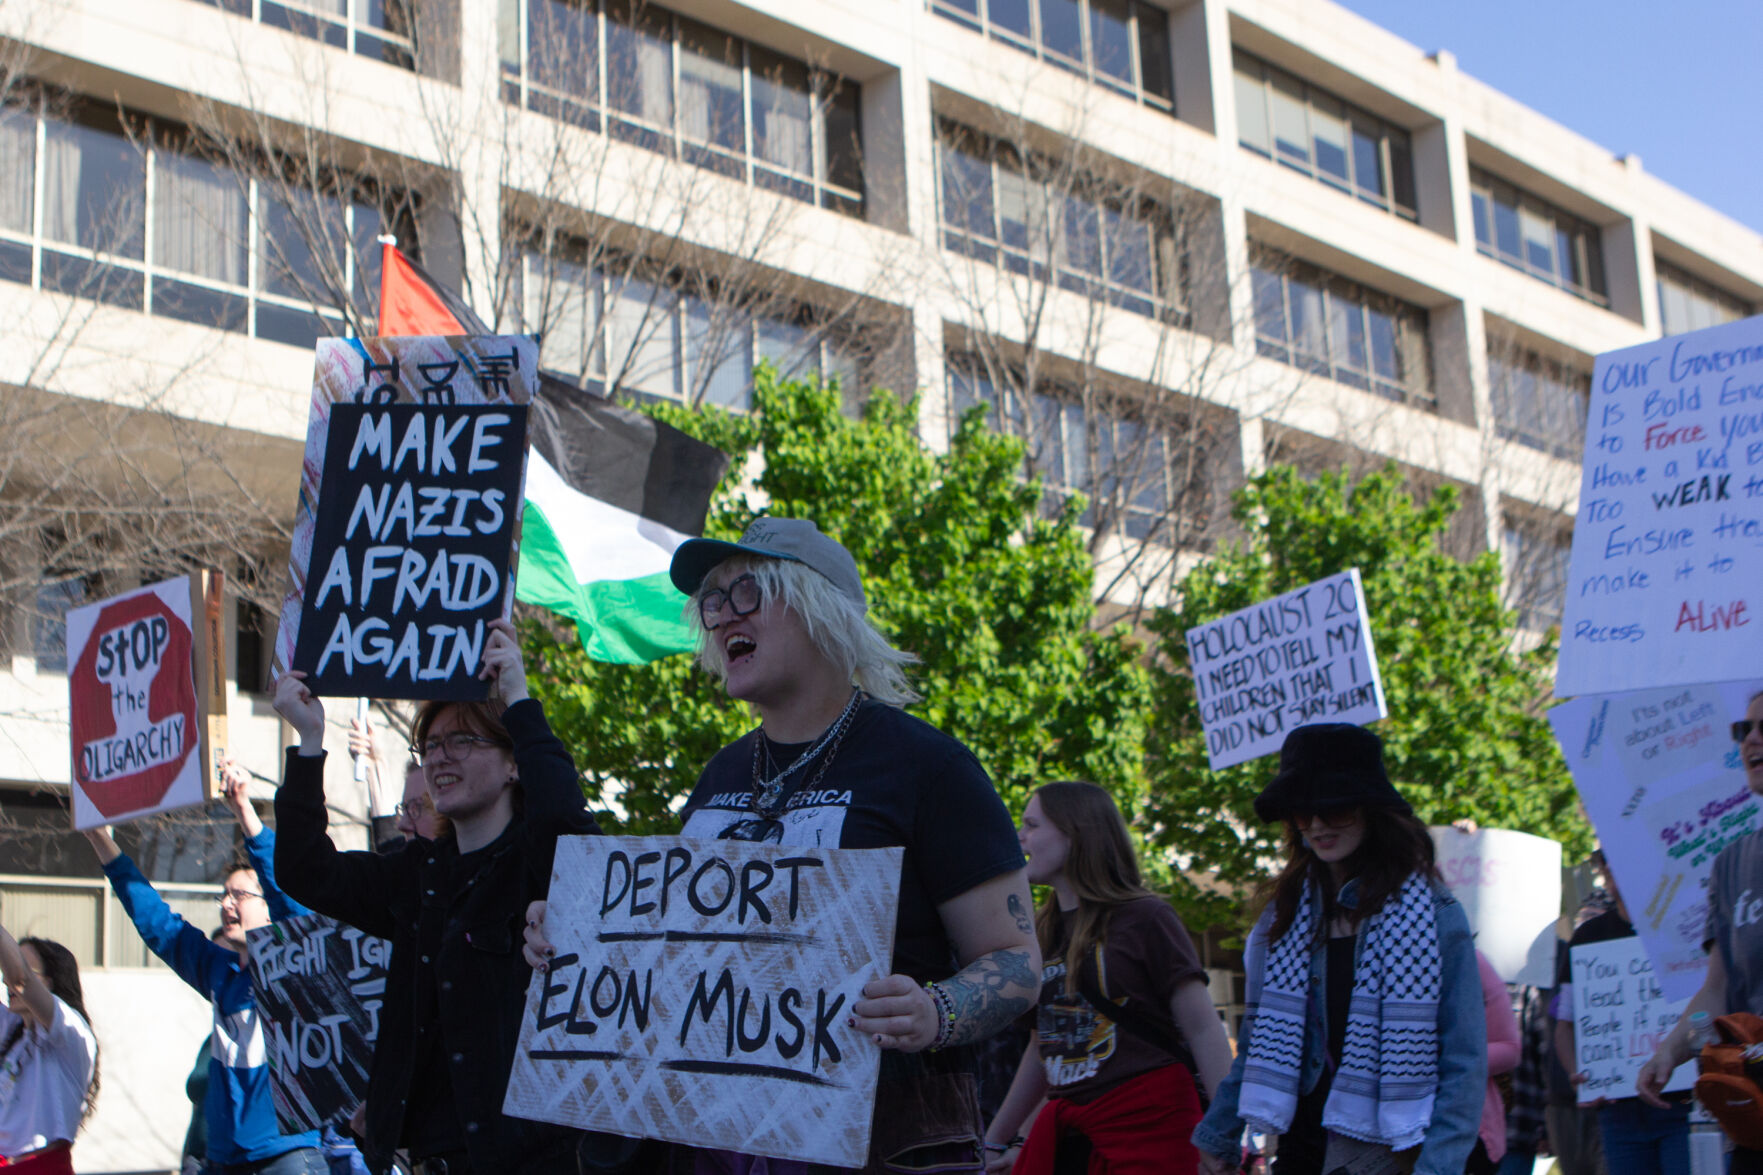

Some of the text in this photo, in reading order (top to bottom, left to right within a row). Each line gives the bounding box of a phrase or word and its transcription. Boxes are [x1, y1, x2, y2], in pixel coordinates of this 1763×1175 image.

[417, 360, 460, 405] DE
[1670, 341, 1763, 384] Govern
[1643, 386, 1701, 422] Bold
[349, 411, 511, 475] MAKE
[1596, 432, 1623, 454] to
[1644, 421, 1708, 452] Force
[1664, 460, 1678, 478] a
[345, 480, 506, 542] NAZIS
[1651, 473, 1732, 511] WEAK
[1604, 524, 1695, 560] Ensure
[1707, 554, 1733, 573] to
[315, 545, 499, 615] AFRAID
[316, 613, 484, 682] AGAIN
[1190, 588, 1312, 664] HOLOCAUST
[1197, 620, 1360, 700] I NEED TO TELL MY
[1202, 657, 1358, 724] CHILDREN THAT I
[113, 682, 146, 716] the
[1209, 681, 1378, 757] DID NOT STAY SILENT
[78, 718, 185, 782] OLIGARCHY
[599, 847, 824, 925] DEPORT
[252, 926, 392, 991] FIGHT IG
[536, 953, 846, 1073] ELON MUSK
[274, 1013, 351, 1082] NOT
